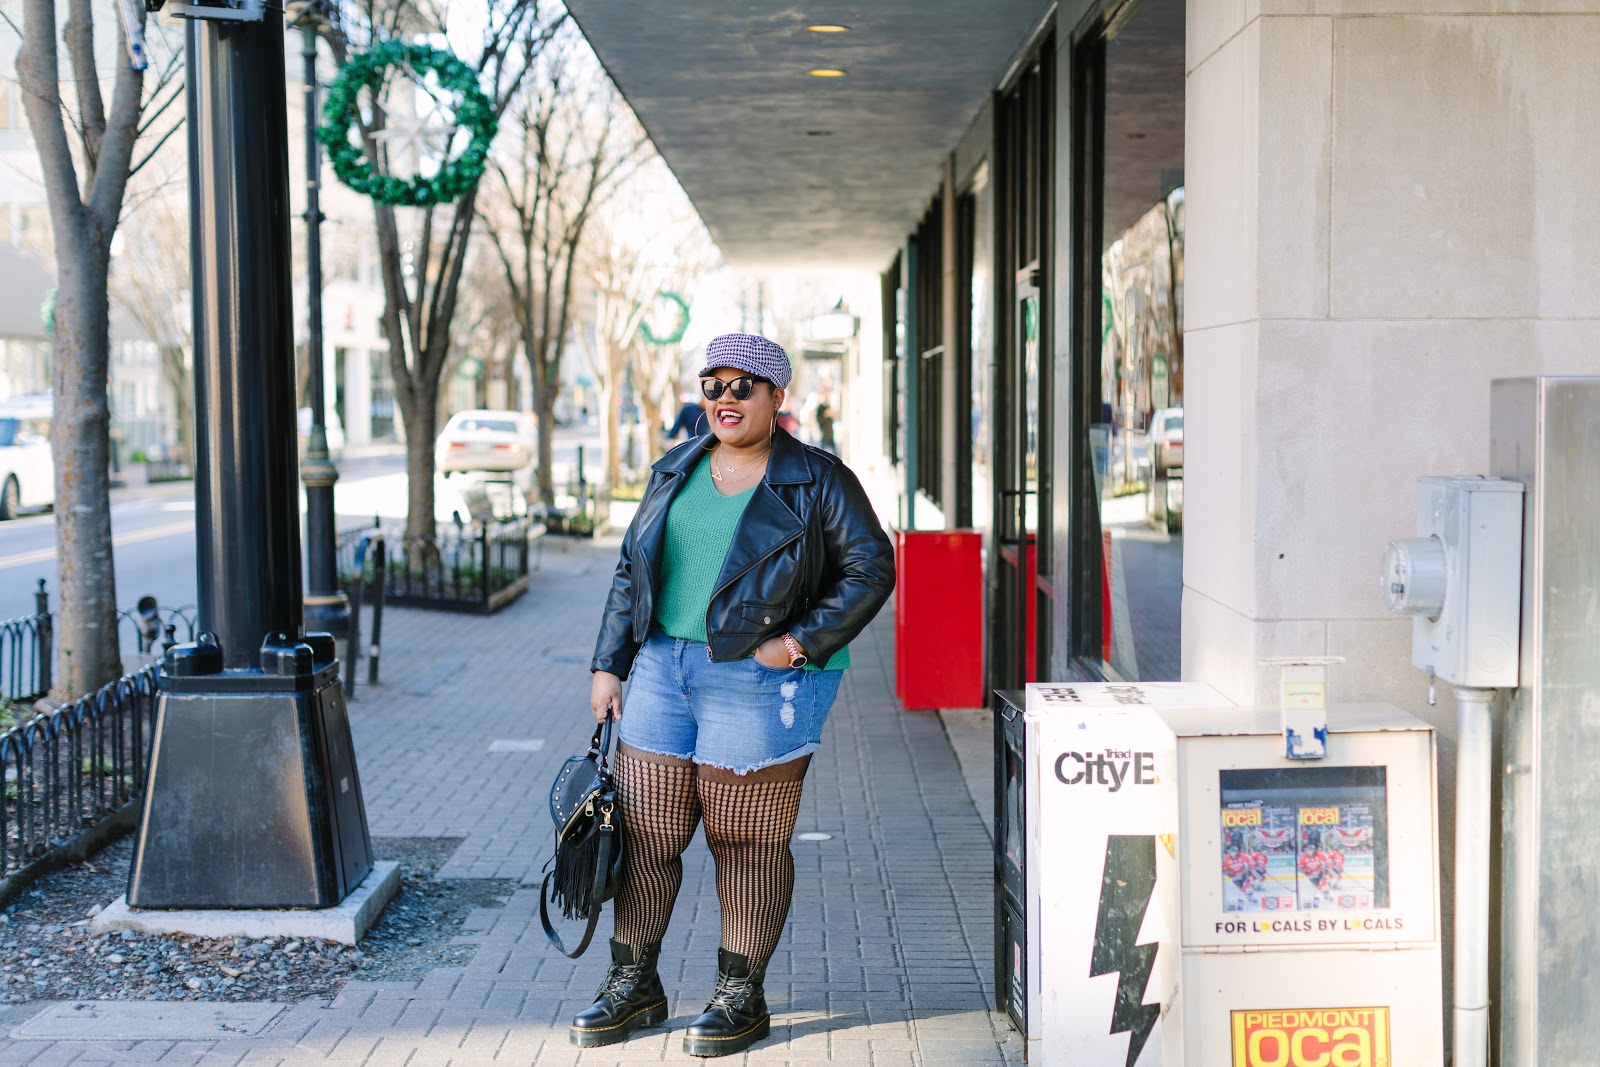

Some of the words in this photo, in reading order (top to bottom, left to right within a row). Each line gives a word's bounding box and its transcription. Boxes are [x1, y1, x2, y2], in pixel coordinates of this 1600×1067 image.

[1104, 748, 1131, 759] Triad
[1215, 921, 1247, 934] FOR
[1318, 919, 1338, 931] BY
[1246, 1010, 1374, 1029] PIEDMONT
